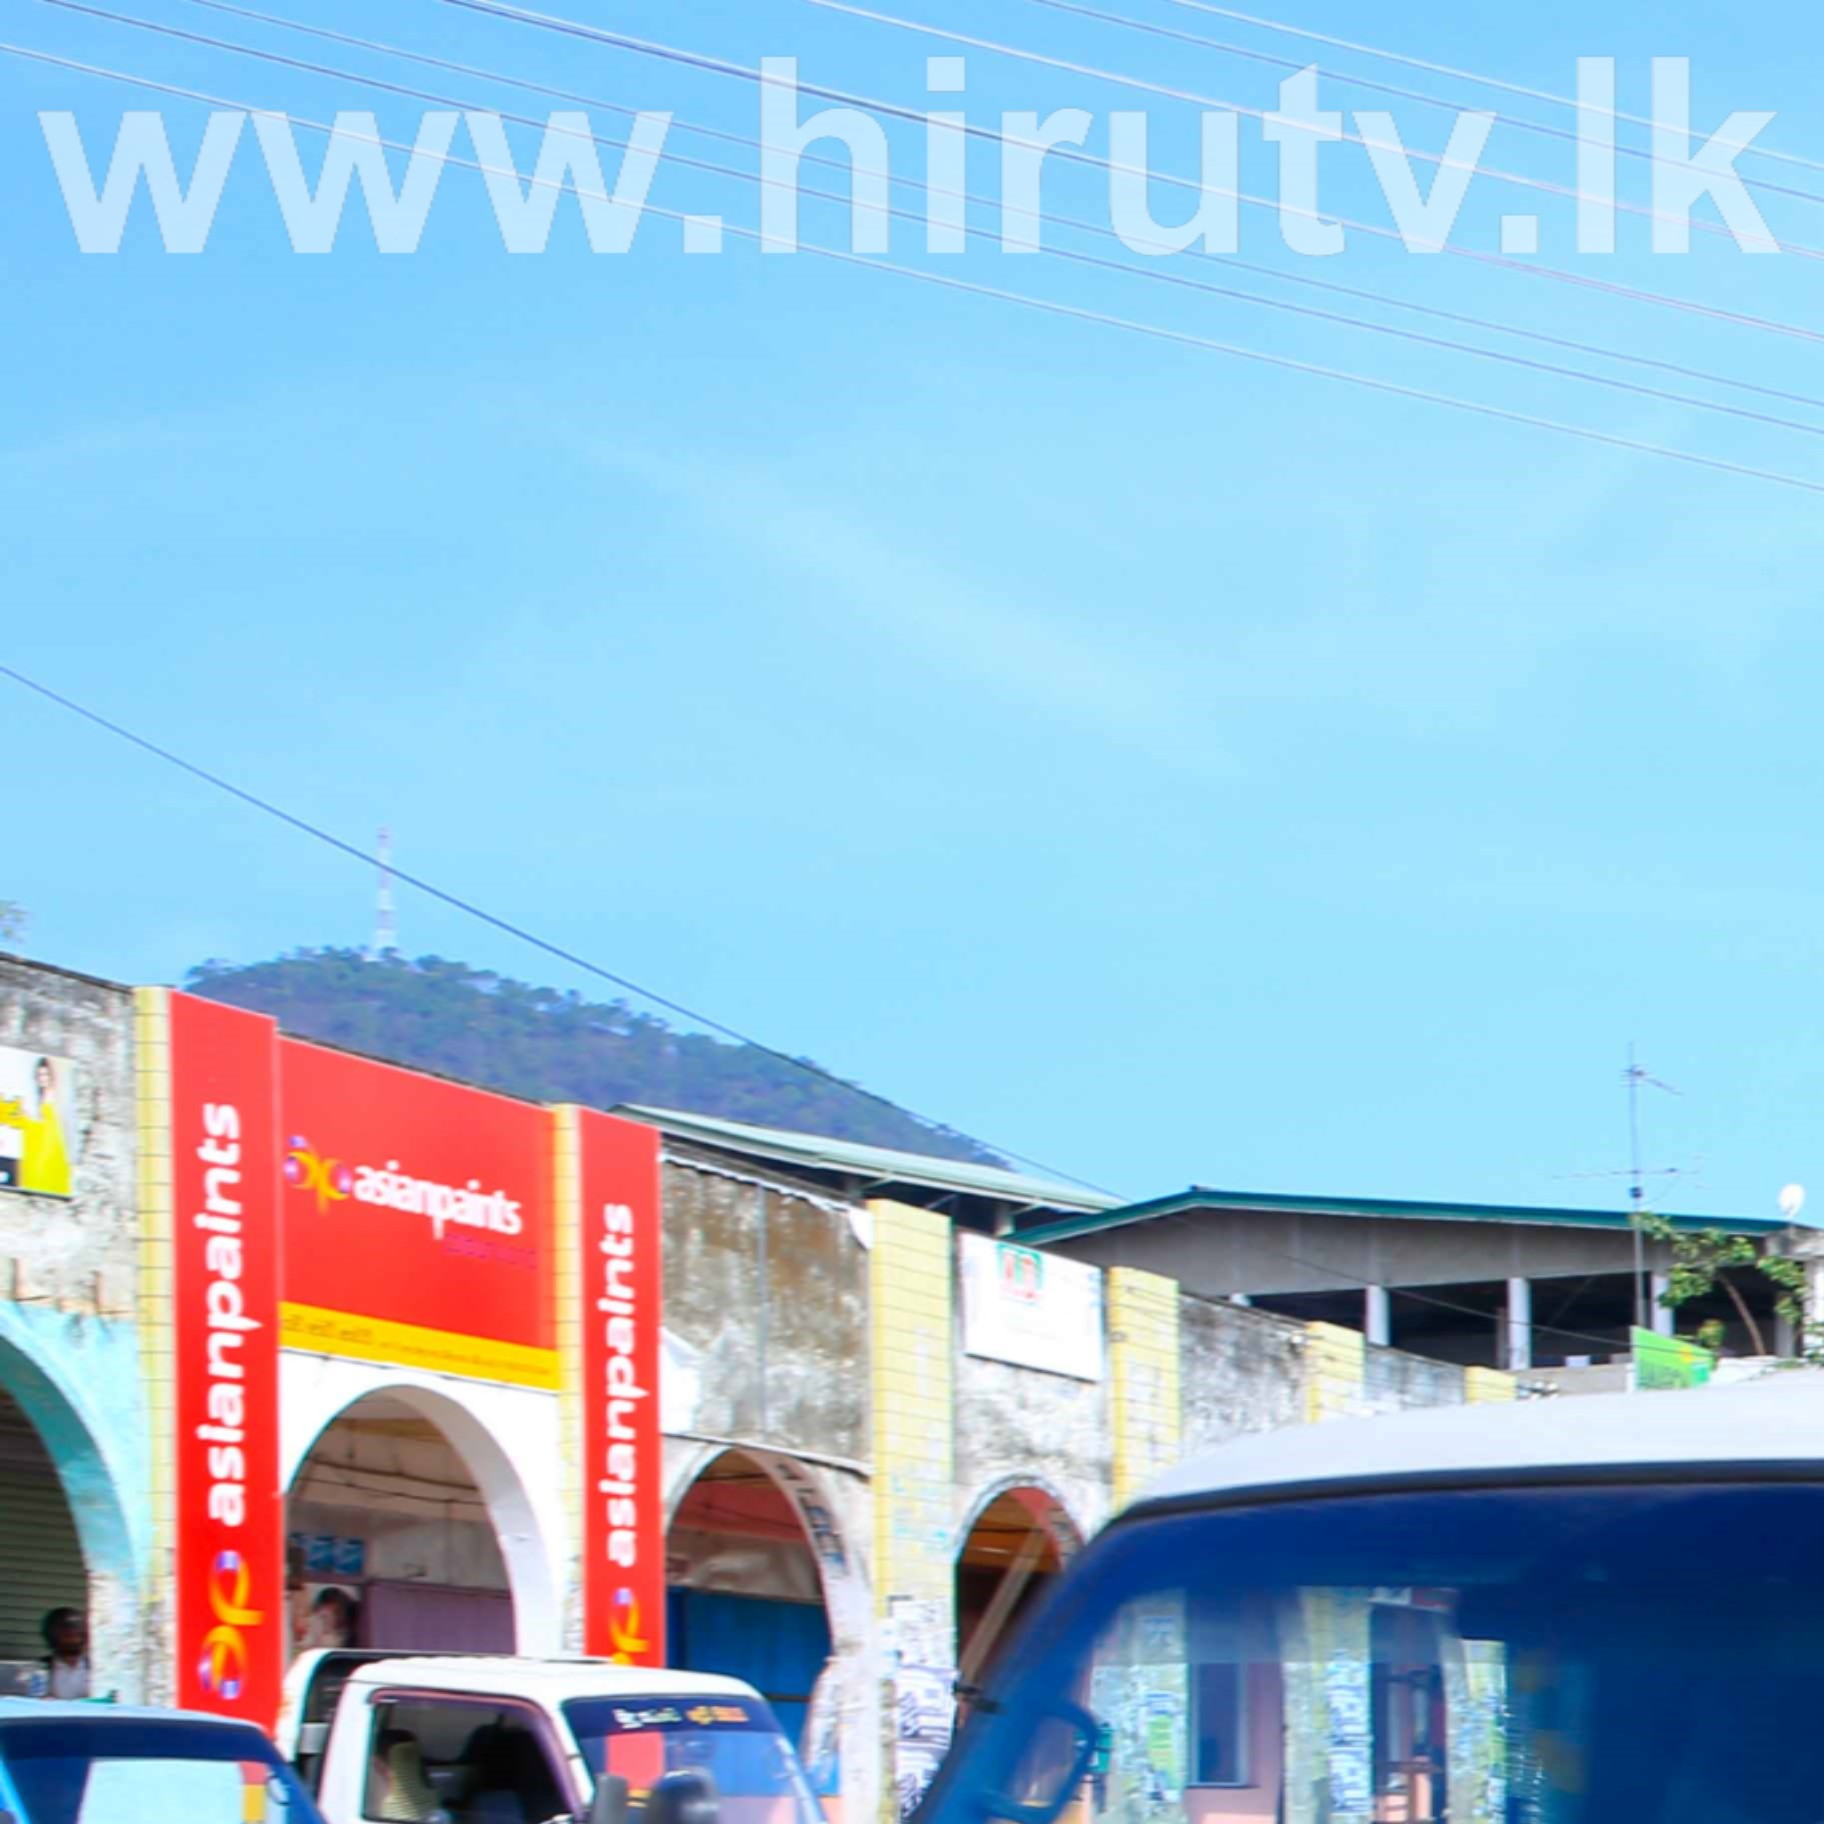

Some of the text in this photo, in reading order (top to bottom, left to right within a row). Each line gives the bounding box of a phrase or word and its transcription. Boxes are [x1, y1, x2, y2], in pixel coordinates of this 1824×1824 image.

[194, 1102, 263, 1528] asianpaints
[351, 1159, 524, 1240] asianpaints
[597, 1203, 650, 1568] asianpaints
